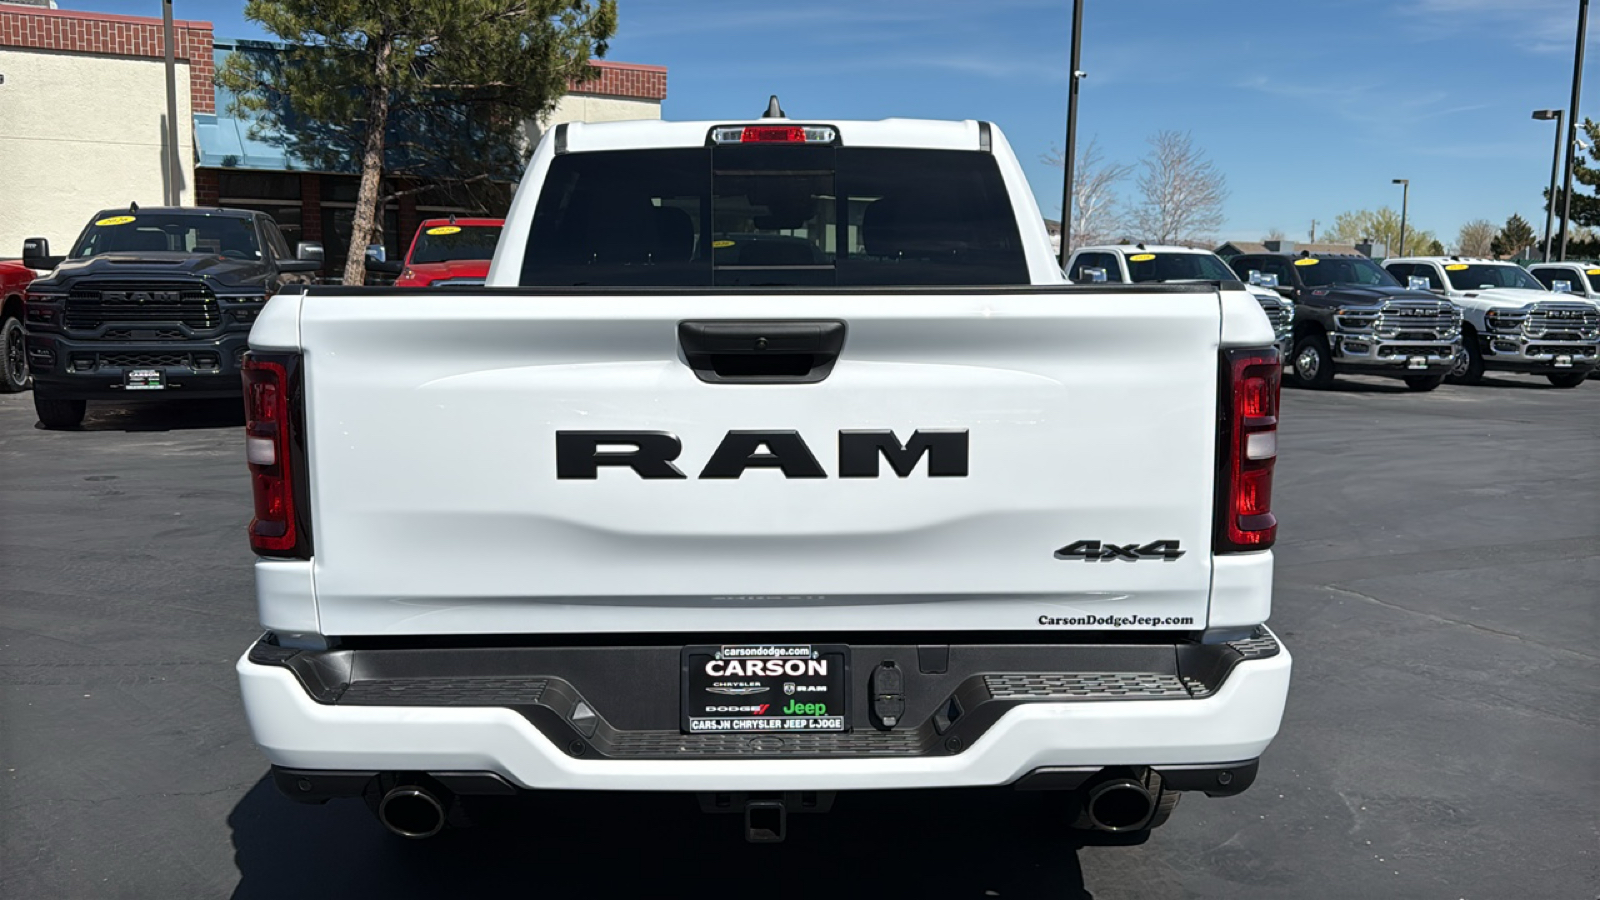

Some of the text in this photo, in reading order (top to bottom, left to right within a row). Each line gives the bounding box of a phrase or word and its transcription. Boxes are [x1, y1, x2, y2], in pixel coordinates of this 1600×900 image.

[102, 289, 179, 300] RAM
[556, 429, 969, 480] RAM
[1053, 539, 1186, 562] 4x4
[1038, 614, 1194, 627] CarsonDodgeJeep.com
[724, 646, 810, 657] carsondodge.com
[705, 659, 828, 676] CARSON
[783, 699, 826, 716] Jeep
[732, 719, 782, 729] CHRYSLER
[783, 719, 807, 729] JEEP
